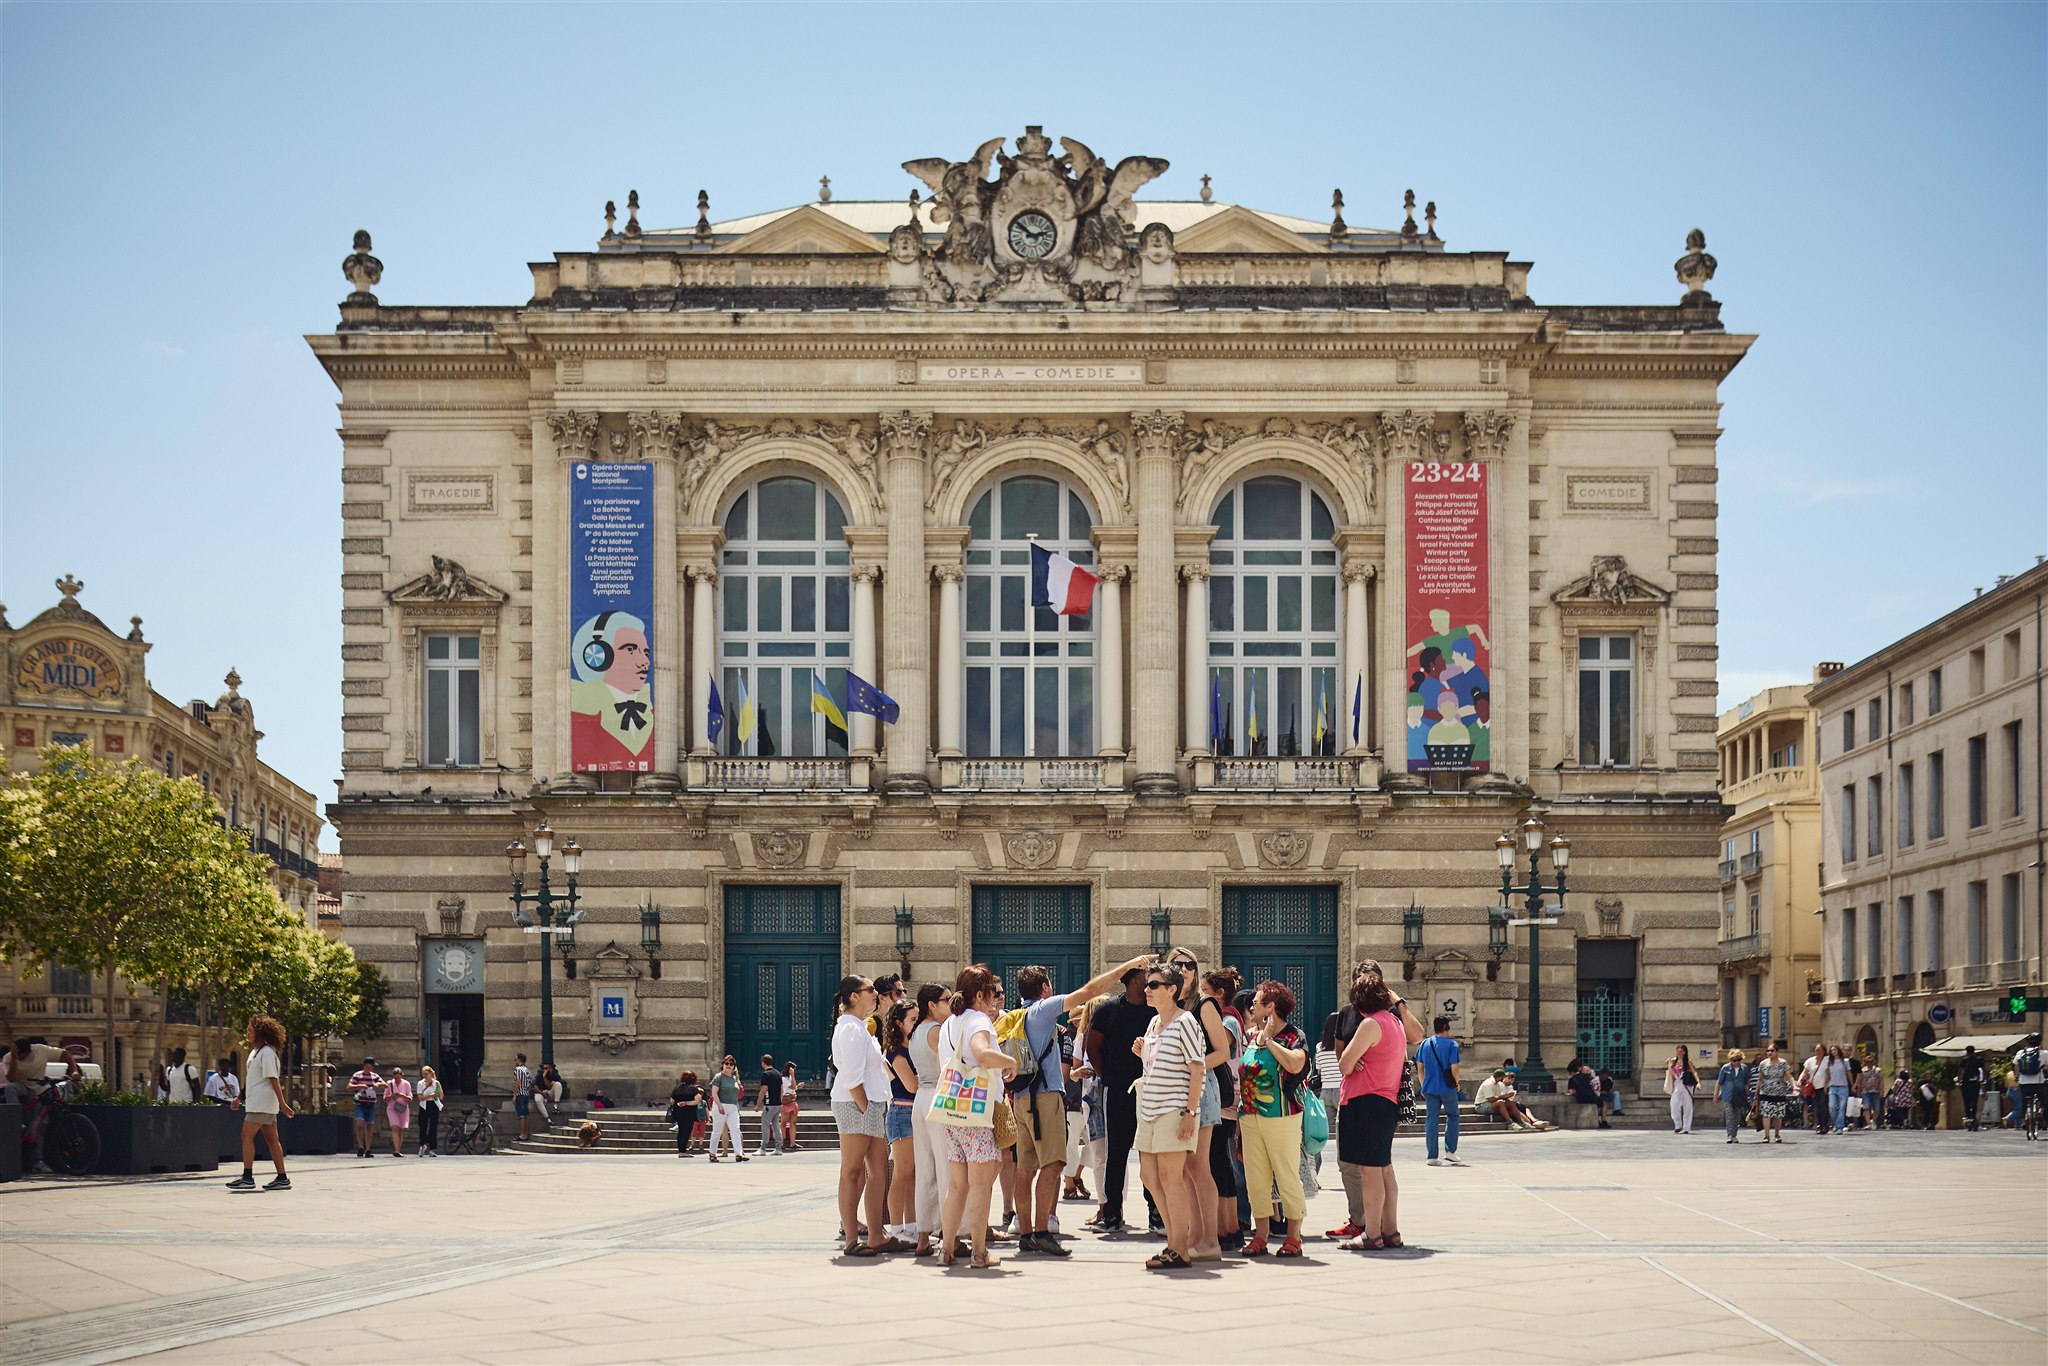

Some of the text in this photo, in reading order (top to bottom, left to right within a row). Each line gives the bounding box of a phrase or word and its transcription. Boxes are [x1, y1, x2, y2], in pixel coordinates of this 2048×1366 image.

[947, 367, 1005, 379] OPERA
[1034, 367, 1116, 379] COMEDIE
[420, 488, 482, 498] TRAGEDIE
[1579, 488, 1637, 498] COMEDIE
[21, 641, 67, 674] GRAND
[42, 662, 96, 688] MIDI
[434, 946, 445, 955] La
[435, 977, 477, 992] Billetterie
